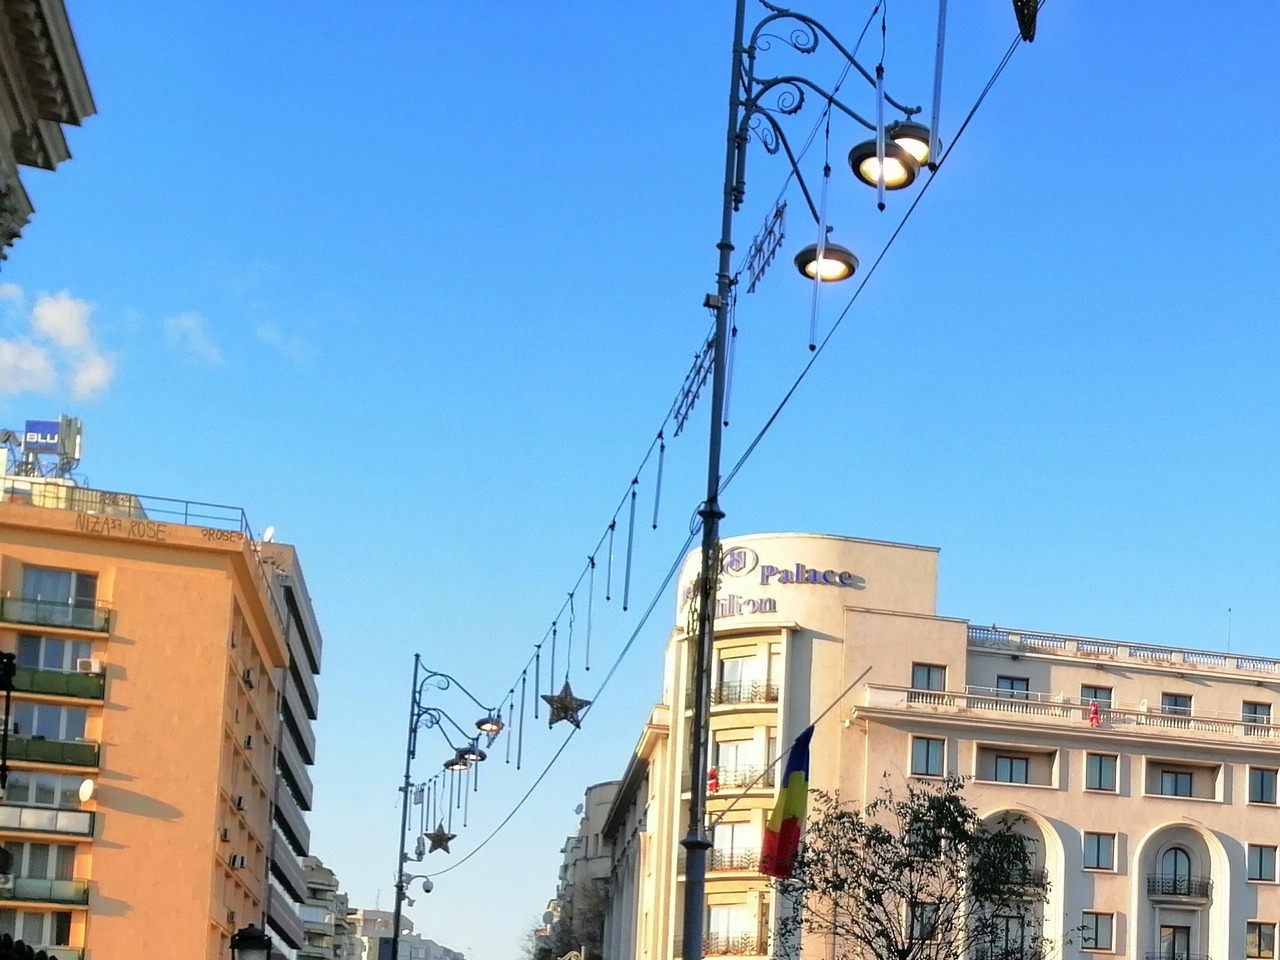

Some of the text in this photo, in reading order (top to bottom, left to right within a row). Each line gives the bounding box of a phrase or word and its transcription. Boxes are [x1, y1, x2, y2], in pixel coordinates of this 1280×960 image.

[26, 432, 58, 443] BLU
[128, 520, 167, 542] ROSE
[207, 529, 237, 543] ROSE
[760, 563, 852, 586] Palace
[714, 594, 777, 619] ilton
